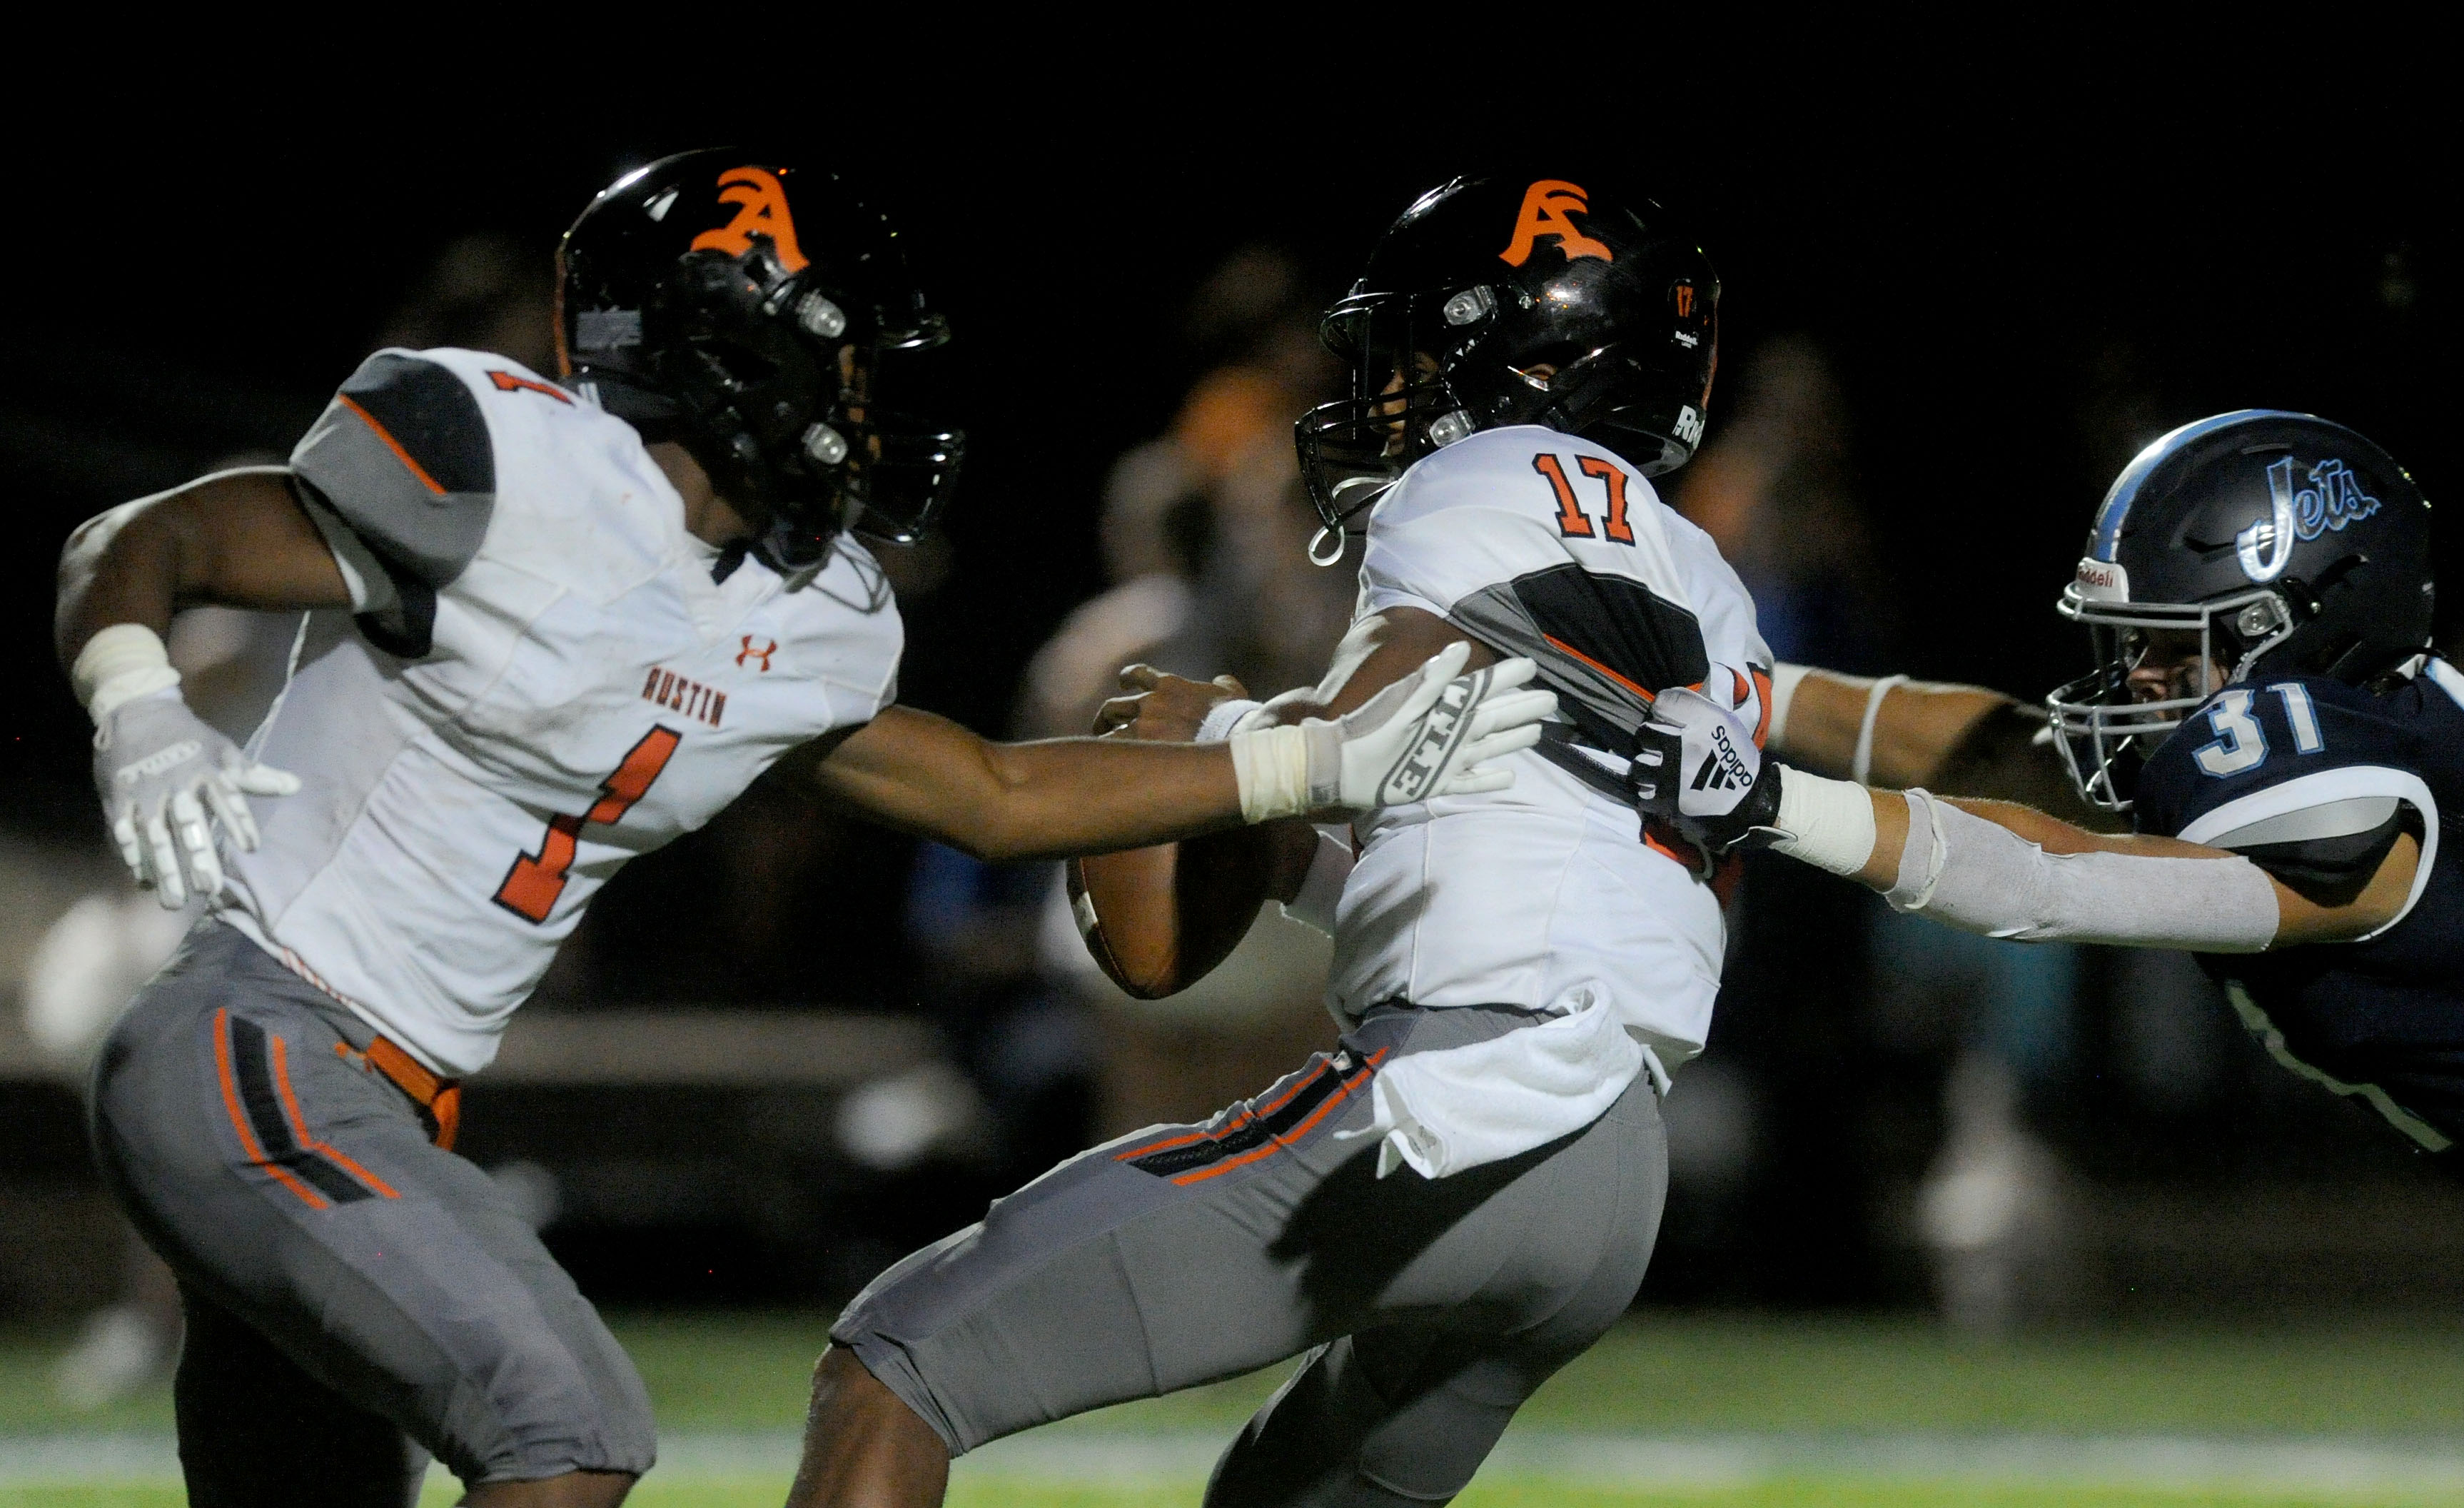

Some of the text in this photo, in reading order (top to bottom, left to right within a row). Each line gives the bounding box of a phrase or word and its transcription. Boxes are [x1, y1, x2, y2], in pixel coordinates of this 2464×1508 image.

[690, 165, 810, 273] A
[1498, 179, 1614, 268] A
[1676, 285, 1694, 318] 17
[1532, 453, 1635, 546] 17
[2236, 455, 2382, 583] Jets
[641, 667, 727, 727] AUSTIN
[2191, 682, 2325, 779] 31
[1711, 725, 1753, 787] adidas
[490, 723, 682, 925] 1
